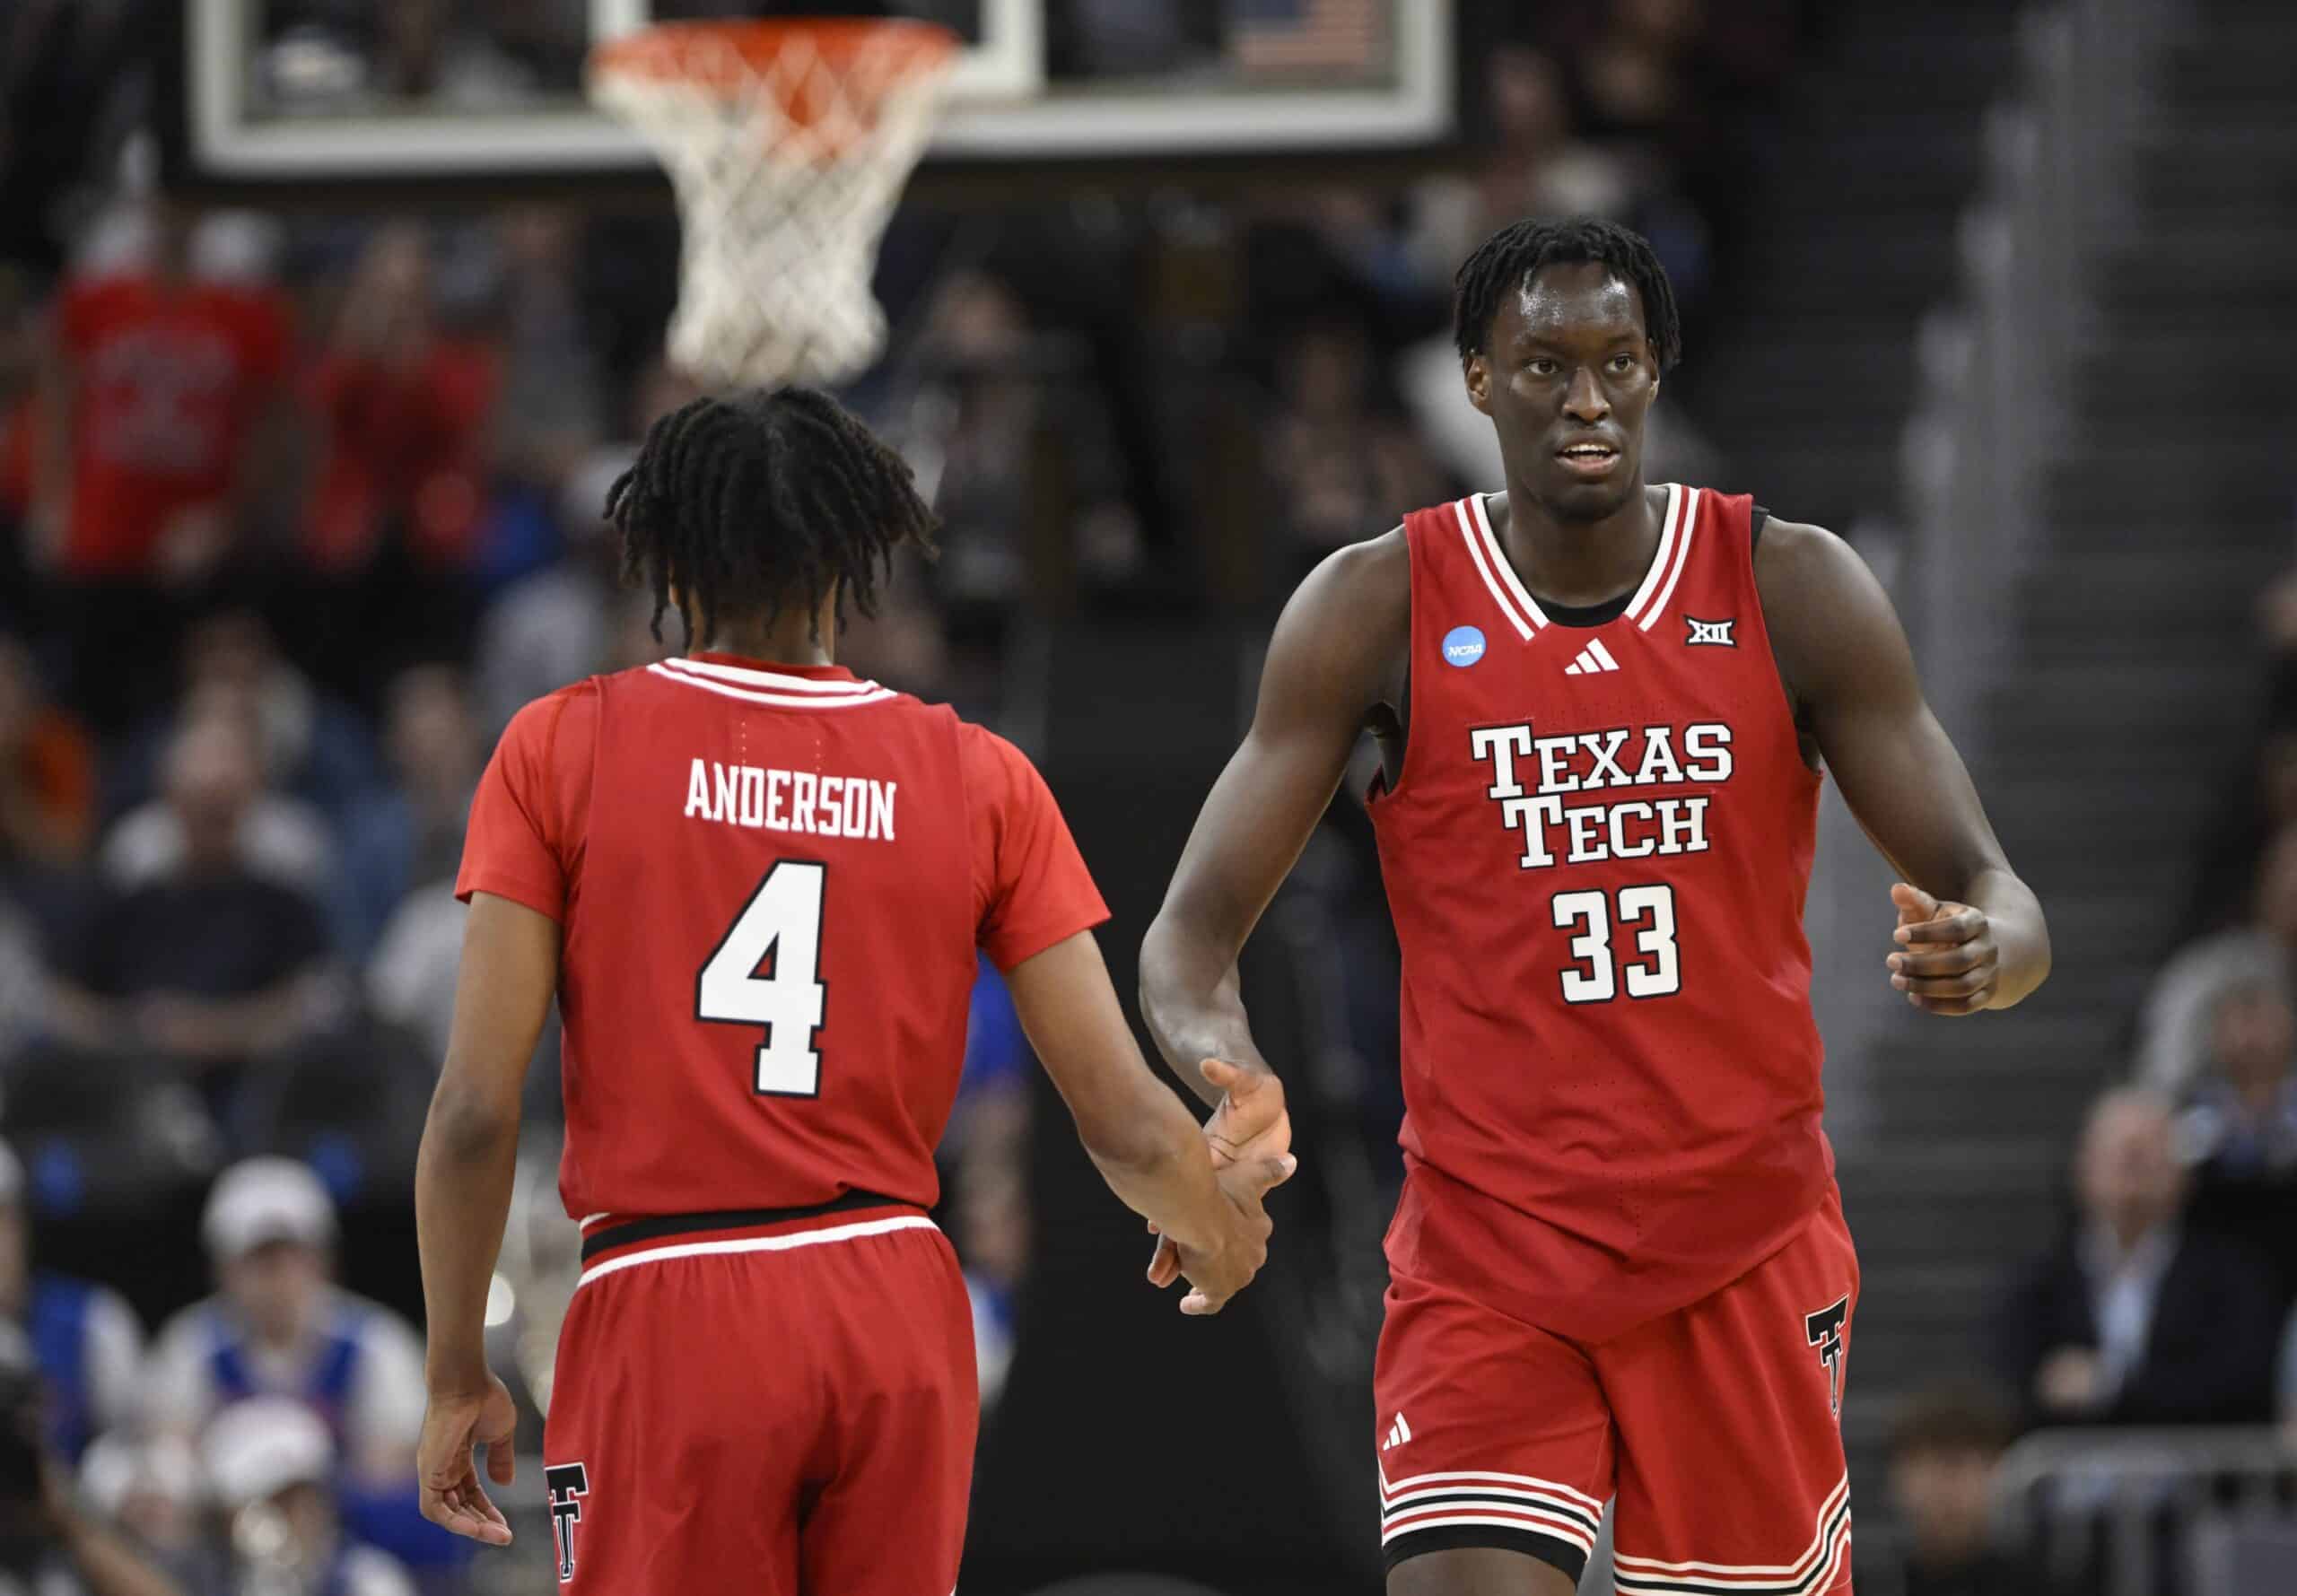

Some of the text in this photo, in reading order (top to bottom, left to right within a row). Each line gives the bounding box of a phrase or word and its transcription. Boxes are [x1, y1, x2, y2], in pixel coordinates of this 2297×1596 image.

[684, 758, 896, 841] ANDERSON
[1471, 724, 1734, 799] TEXAS
[1502, 794, 1709, 869] TECH
[694, 858, 827, 1098] 4
[1551, 883, 1681, 1004] 33
